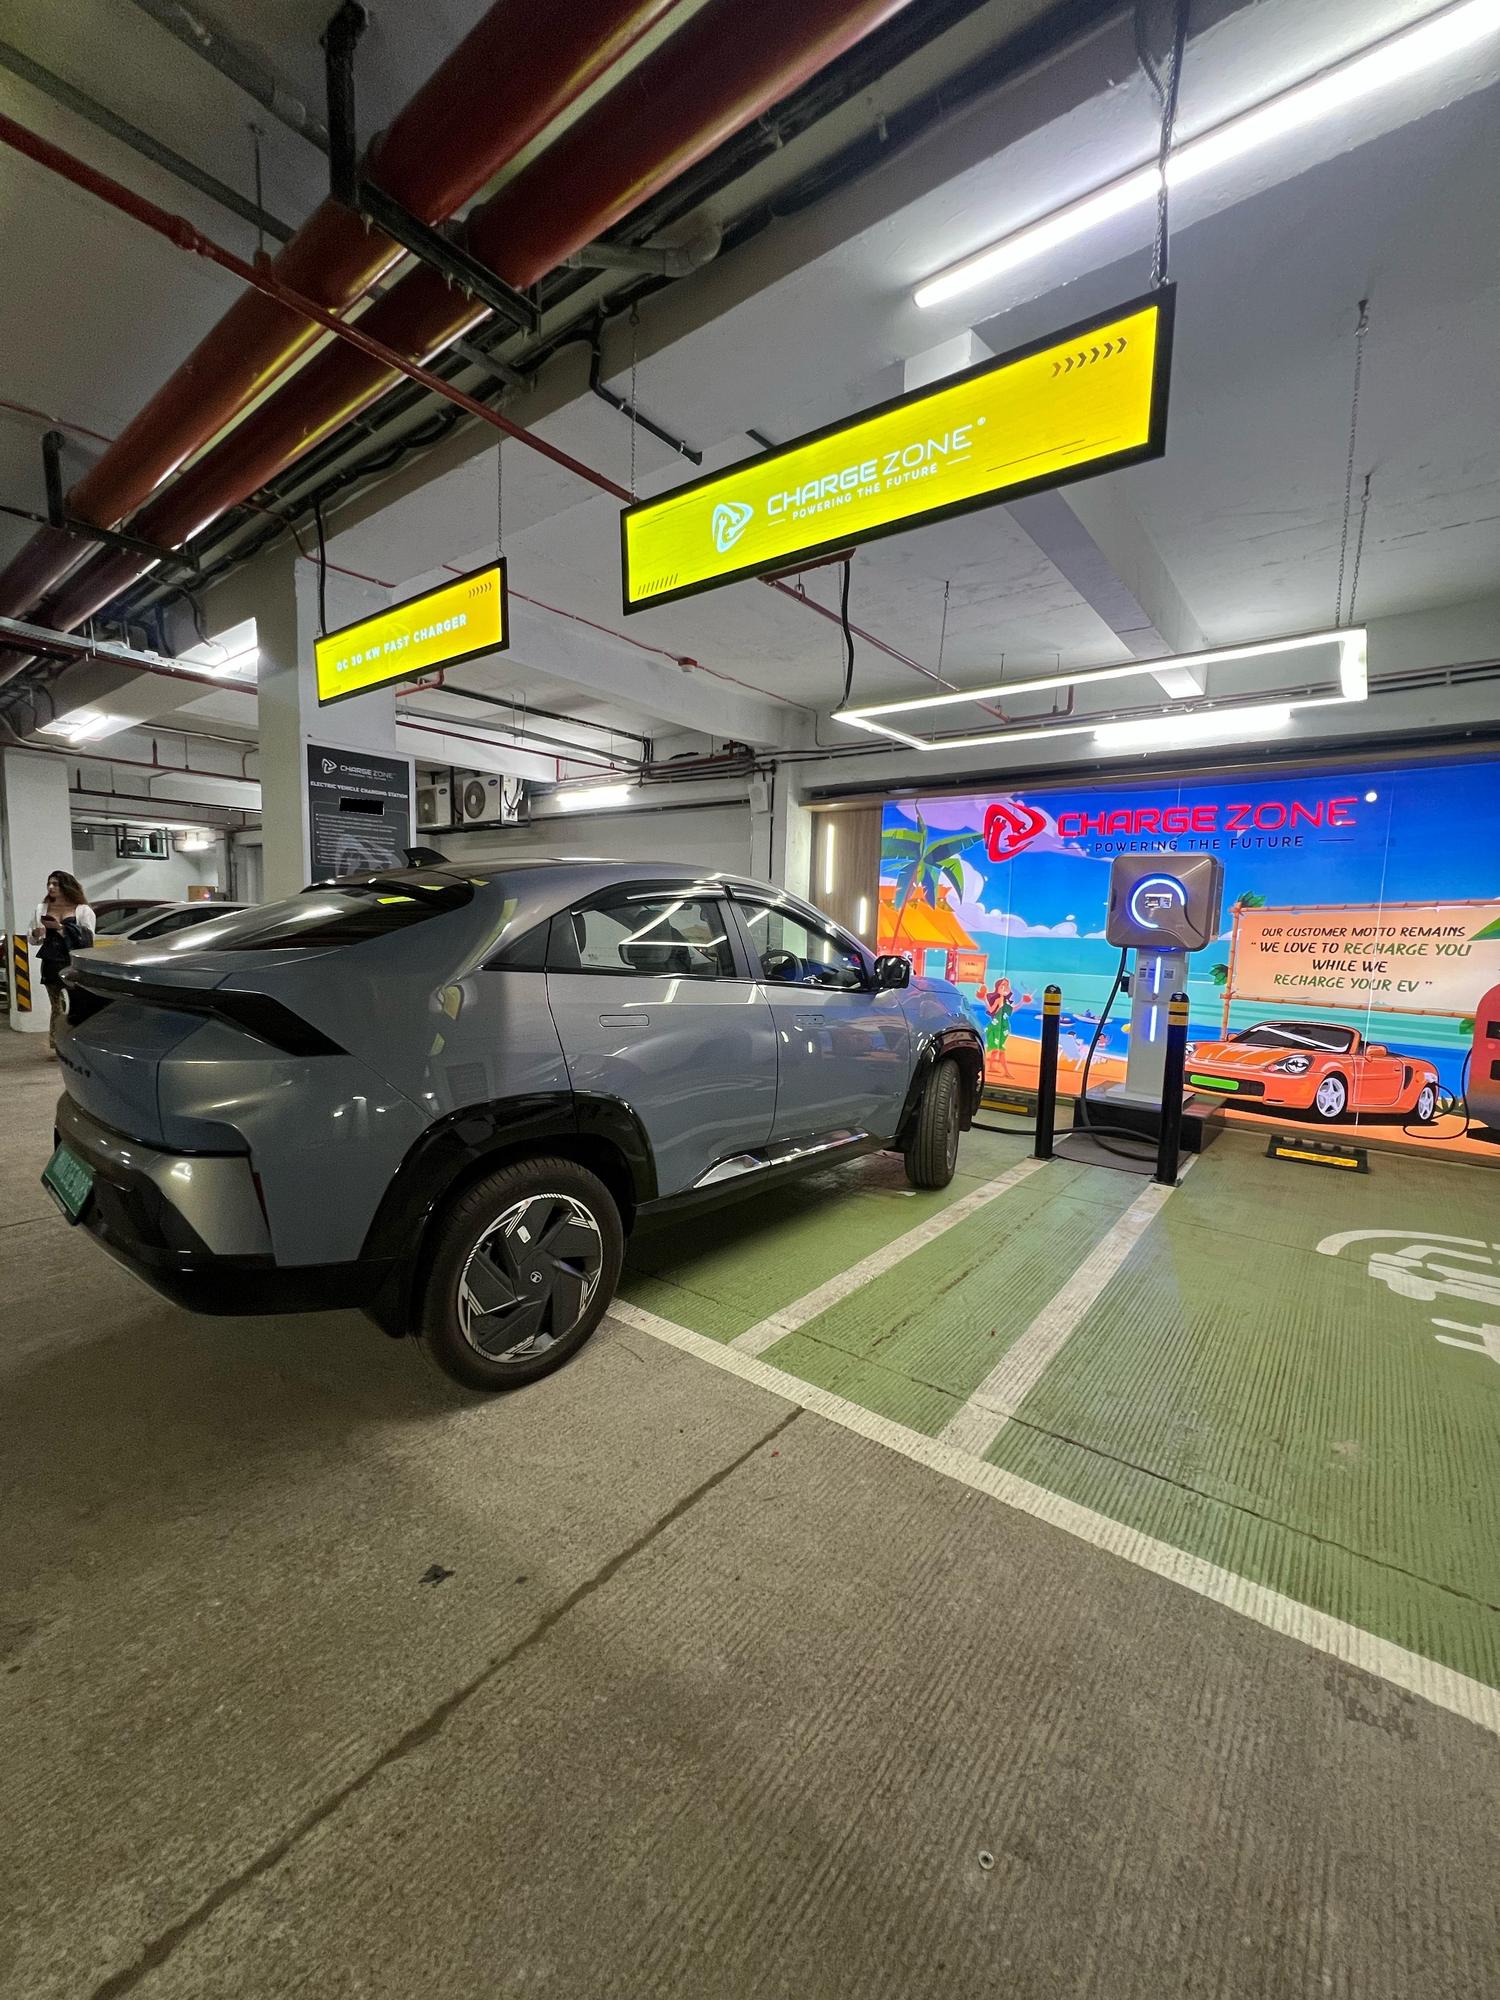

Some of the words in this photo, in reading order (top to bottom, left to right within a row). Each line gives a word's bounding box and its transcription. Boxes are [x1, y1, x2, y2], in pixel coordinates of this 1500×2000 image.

[767, 459, 878, 515] CHARGE
[883, 424, 973, 476] ZONE
[792, 493, 852, 521] POWERING
[857, 482, 880, 498] THE
[886, 463, 937, 489] FUTURE
[336, 658, 349, 672] DC
[351, 654, 362, 666] 30
[365, 646, 380, 661] KW
[384, 635, 410, 654] FAST
[413, 613, 467, 643] CHARGER
[340, 765, 372, 776] CHARGE
[373, 770, 393, 779] ZONE
[310, 781, 337, 789] ELECTRIC
[337, 784, 360, 792] VEHICLE
[360, 788, 387, 796] CHARGING
[387, 791, 408, 799] STATION
[1057, 806, 1218, 837] CHARGE
[1224, 797, 1359, 831] ZONE
[1095, 839, 1178, 852] POWERING
[1188, 838, 1221, 850] THE
[1230, 835, 1305, 849] FUTURE
[1261, 927, 1283, 937] OUR
[1286, 927, 1347, 937] CUSTOMER
[1351, 927, 1396, 937] MOTTO
[1400, 926, 1466, 937] REMAINS
[1260, 942, 1280, 953] WE
[1284, 942, 1317, 953] LOVE
[1321, 943, 1339, 953] TO
[1343, 943, 1428, 956] RECHARGE
[1435, 943, 1473, 957] YOU
[1312, 959, 1357, 972] WHILE
[1361, 960, 1388, 973] WE
[1273, 974, 1345, 988] RECHARGE
[1350, 977, 1392, 992] YOUR
[1397, 979, 1420, 993] EV
